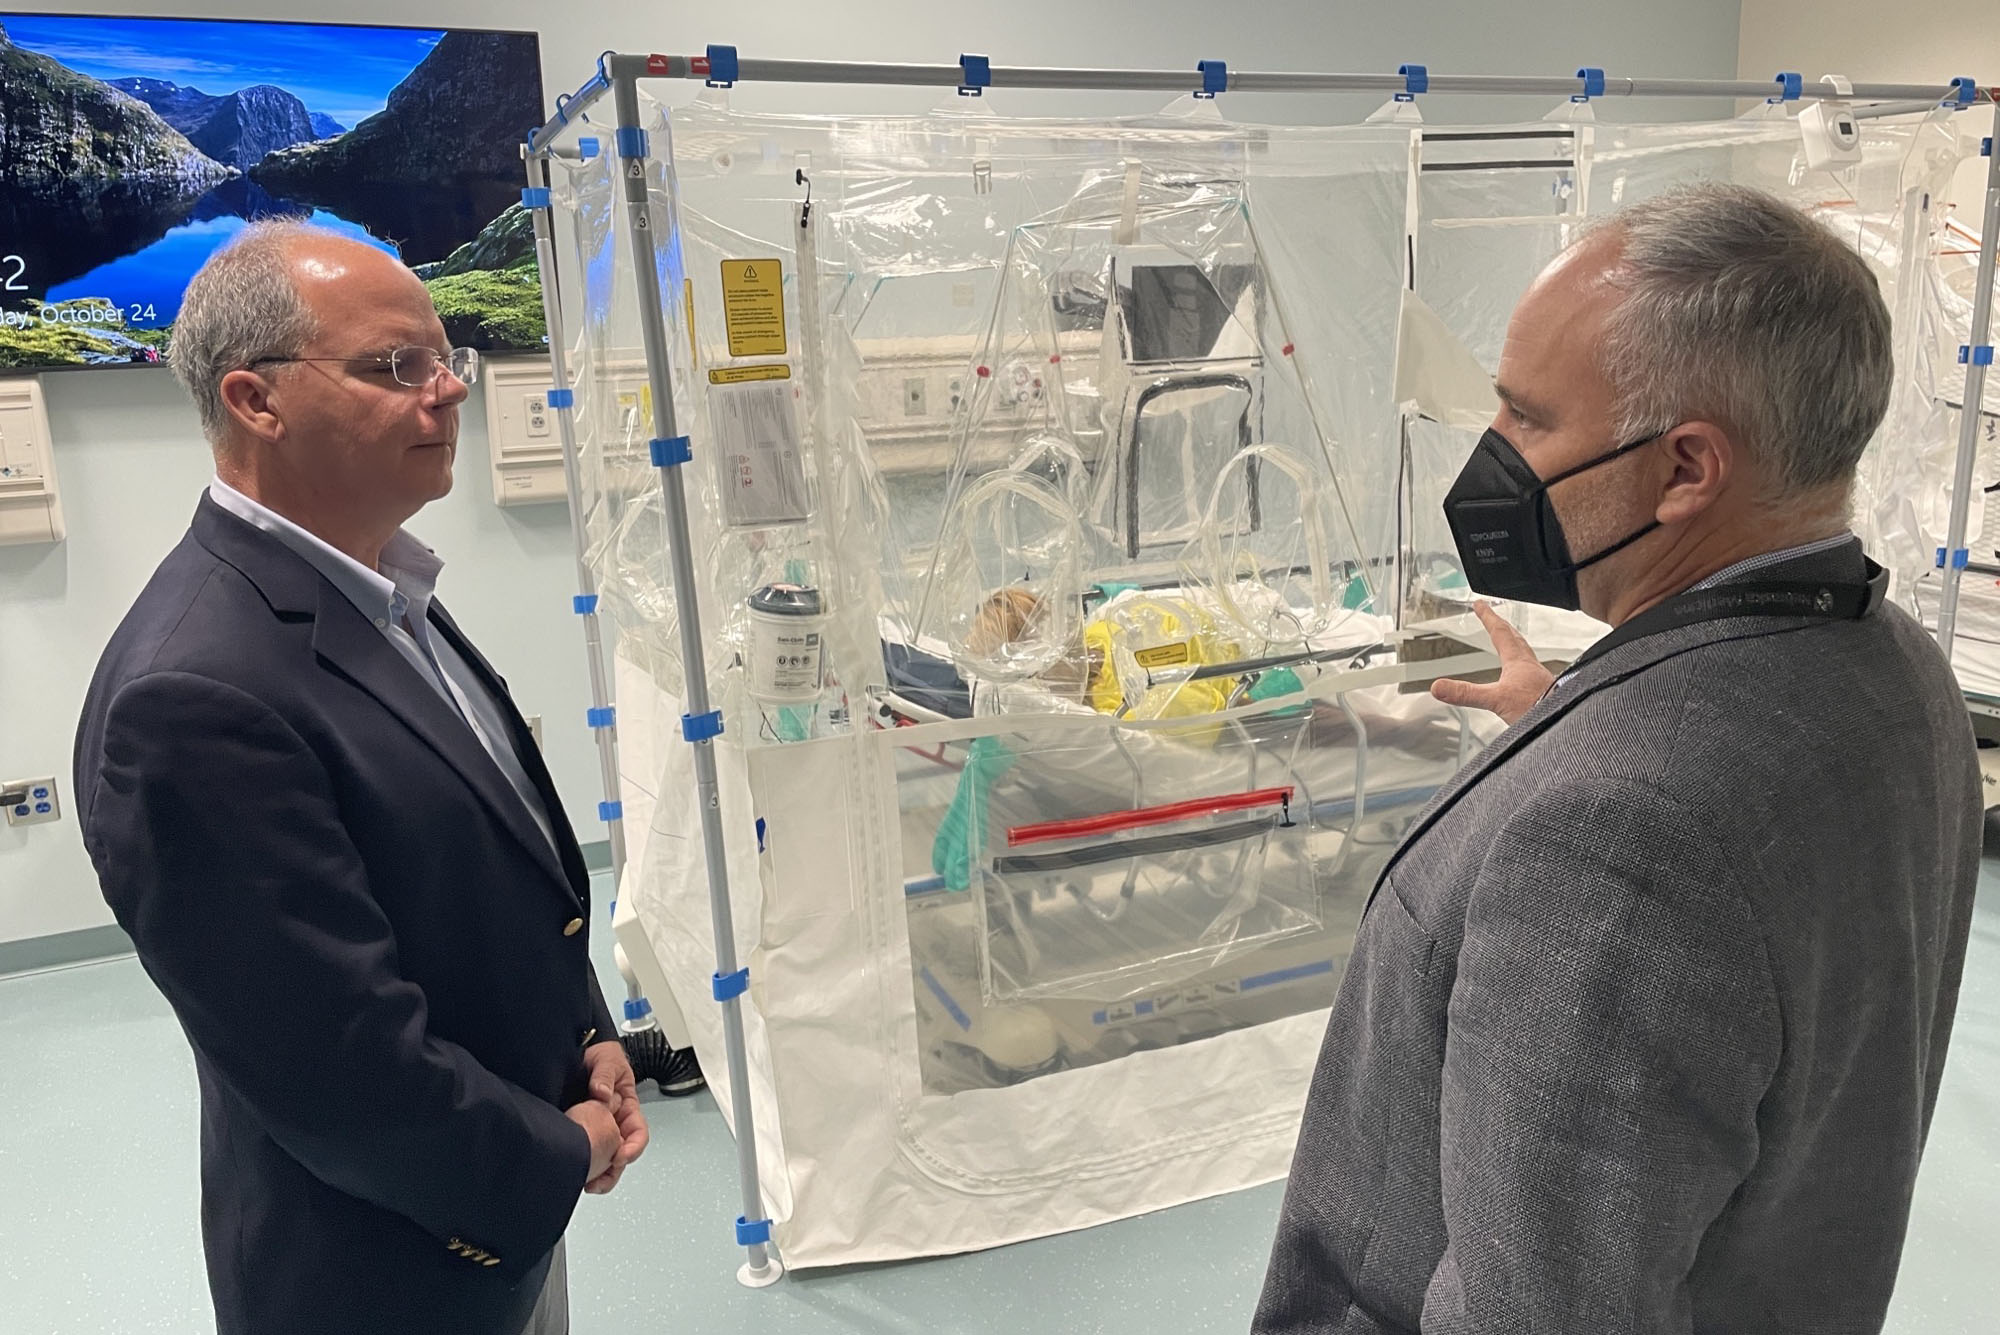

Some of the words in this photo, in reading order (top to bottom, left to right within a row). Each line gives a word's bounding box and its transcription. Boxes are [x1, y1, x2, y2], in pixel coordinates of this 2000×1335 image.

[632, 165, 640, 176] 3
[639, 217, 647, 228] 3
[0, 255, 29, 290] 2
[40, 305, 125, 324] October
[130, 303, 157, 322] 24
[711, 796, 718, 807] 3
